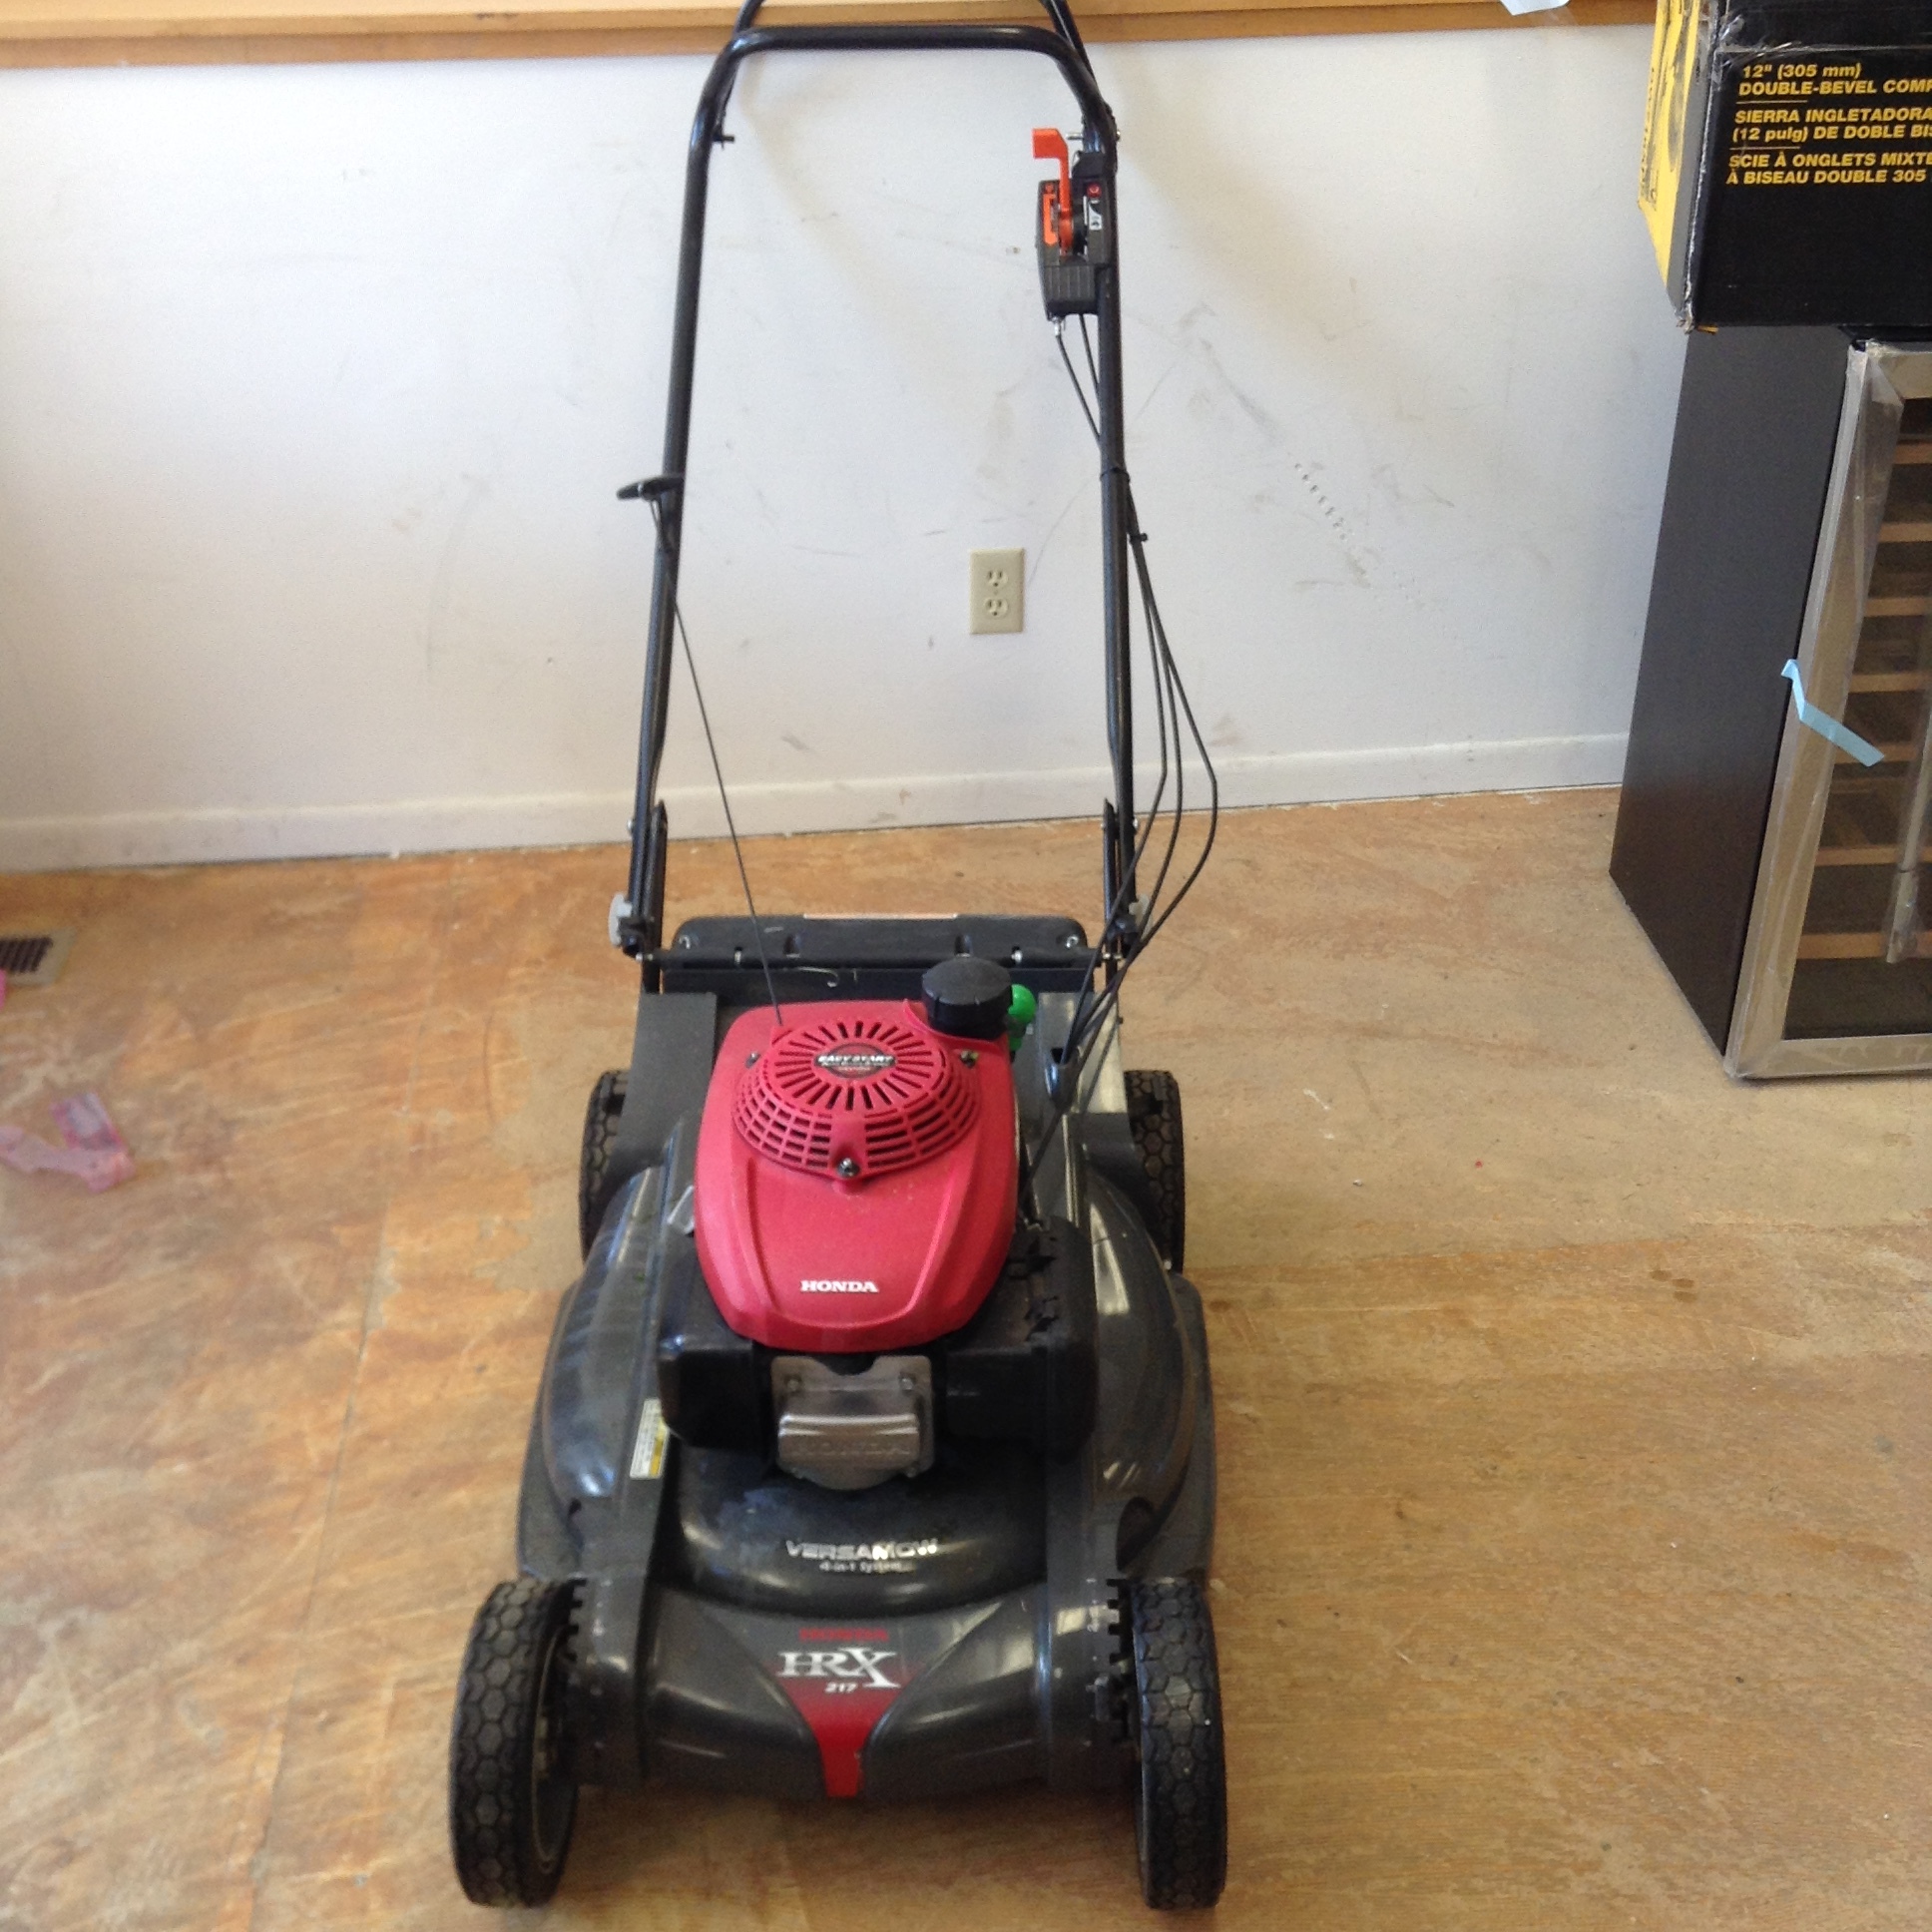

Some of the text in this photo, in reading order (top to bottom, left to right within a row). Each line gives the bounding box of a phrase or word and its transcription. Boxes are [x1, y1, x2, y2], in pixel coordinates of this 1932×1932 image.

[1743, 63, 1861, 80] 12" (305 mm)
[1738, 80, 1877, 96] DOUBLE-BEVEL
[1734, 107, 1932, 124] SIERRA INGLETADORA
[1732, 124, 1932, 143] (12 pulg) DE DOBLE BI
[1728, 154, 1770, 168] SCIE
[1774, 151, 1787, 168] À
[1792, 153, 1877, 168] ONGLETS
[1743, 171, 1810, 185] BISEAU
[1813, 170, 1888, 184] DOUBLE
[1892, 169, 1926, 183] 305
[800, 1279, 879, 1293] HONDA
[777, 1647, 901, 1689] HRX
[824, 1682, 858, 1693] 217
